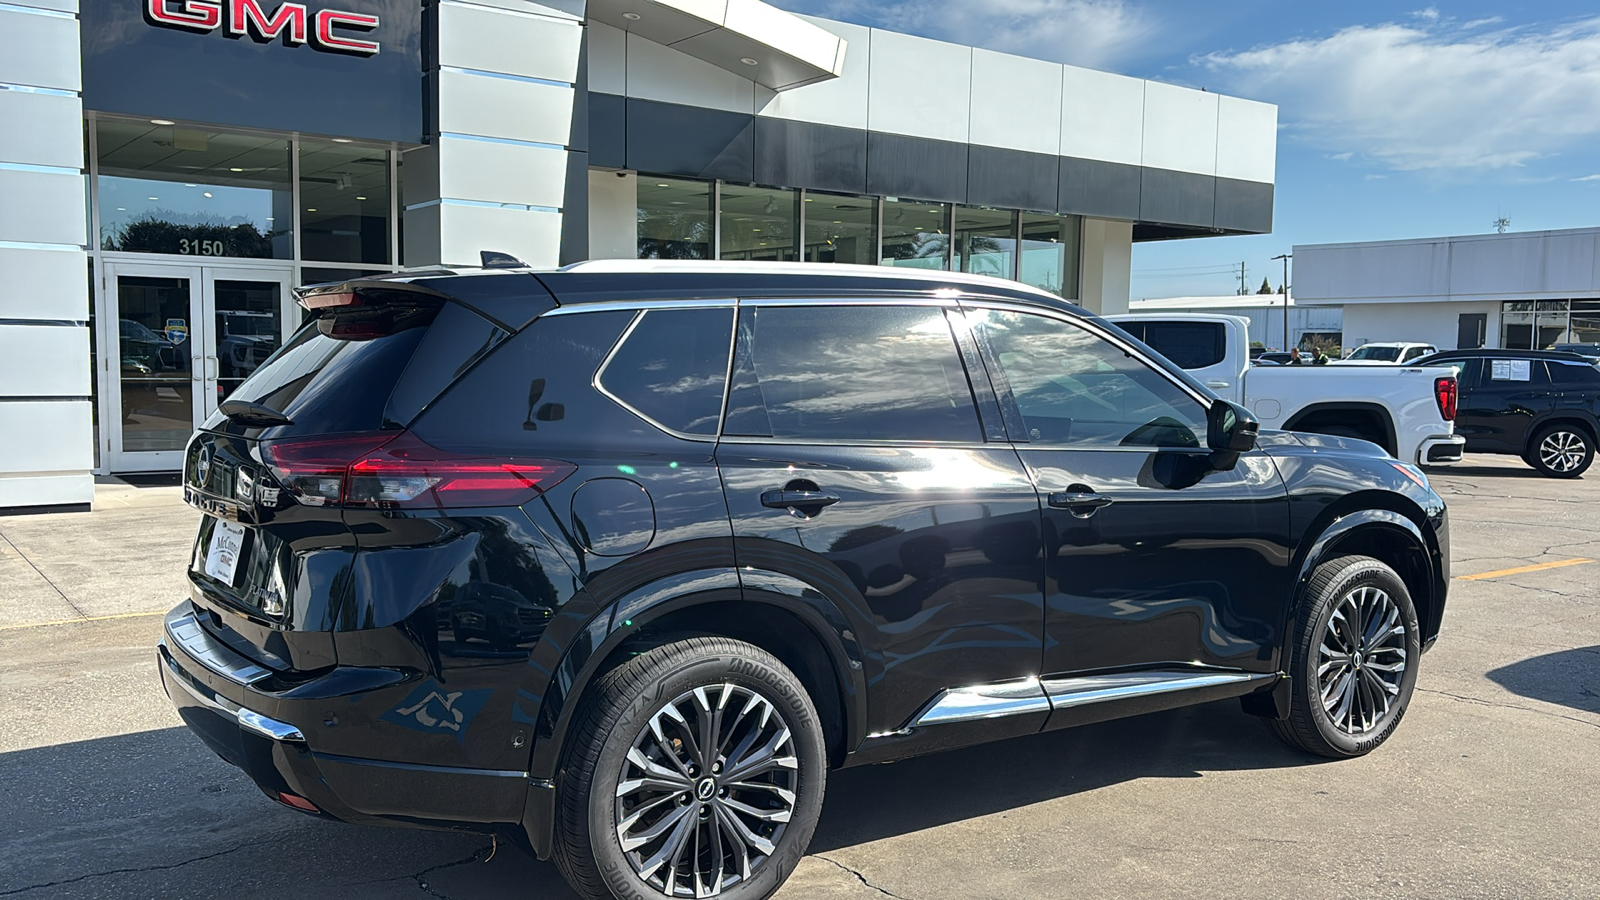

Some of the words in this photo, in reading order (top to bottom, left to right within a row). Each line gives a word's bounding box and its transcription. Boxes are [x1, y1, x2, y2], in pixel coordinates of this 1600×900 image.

[149, 0, 380, 54] GMC
[179, 238, 224, 256] 3150
[1326, 569, 1381, 612] BRIDGESTONE
[727, 657, 814, 730] BRIDGESTONE
[1355, 706, 1406, 753] BRIDGESTONE
